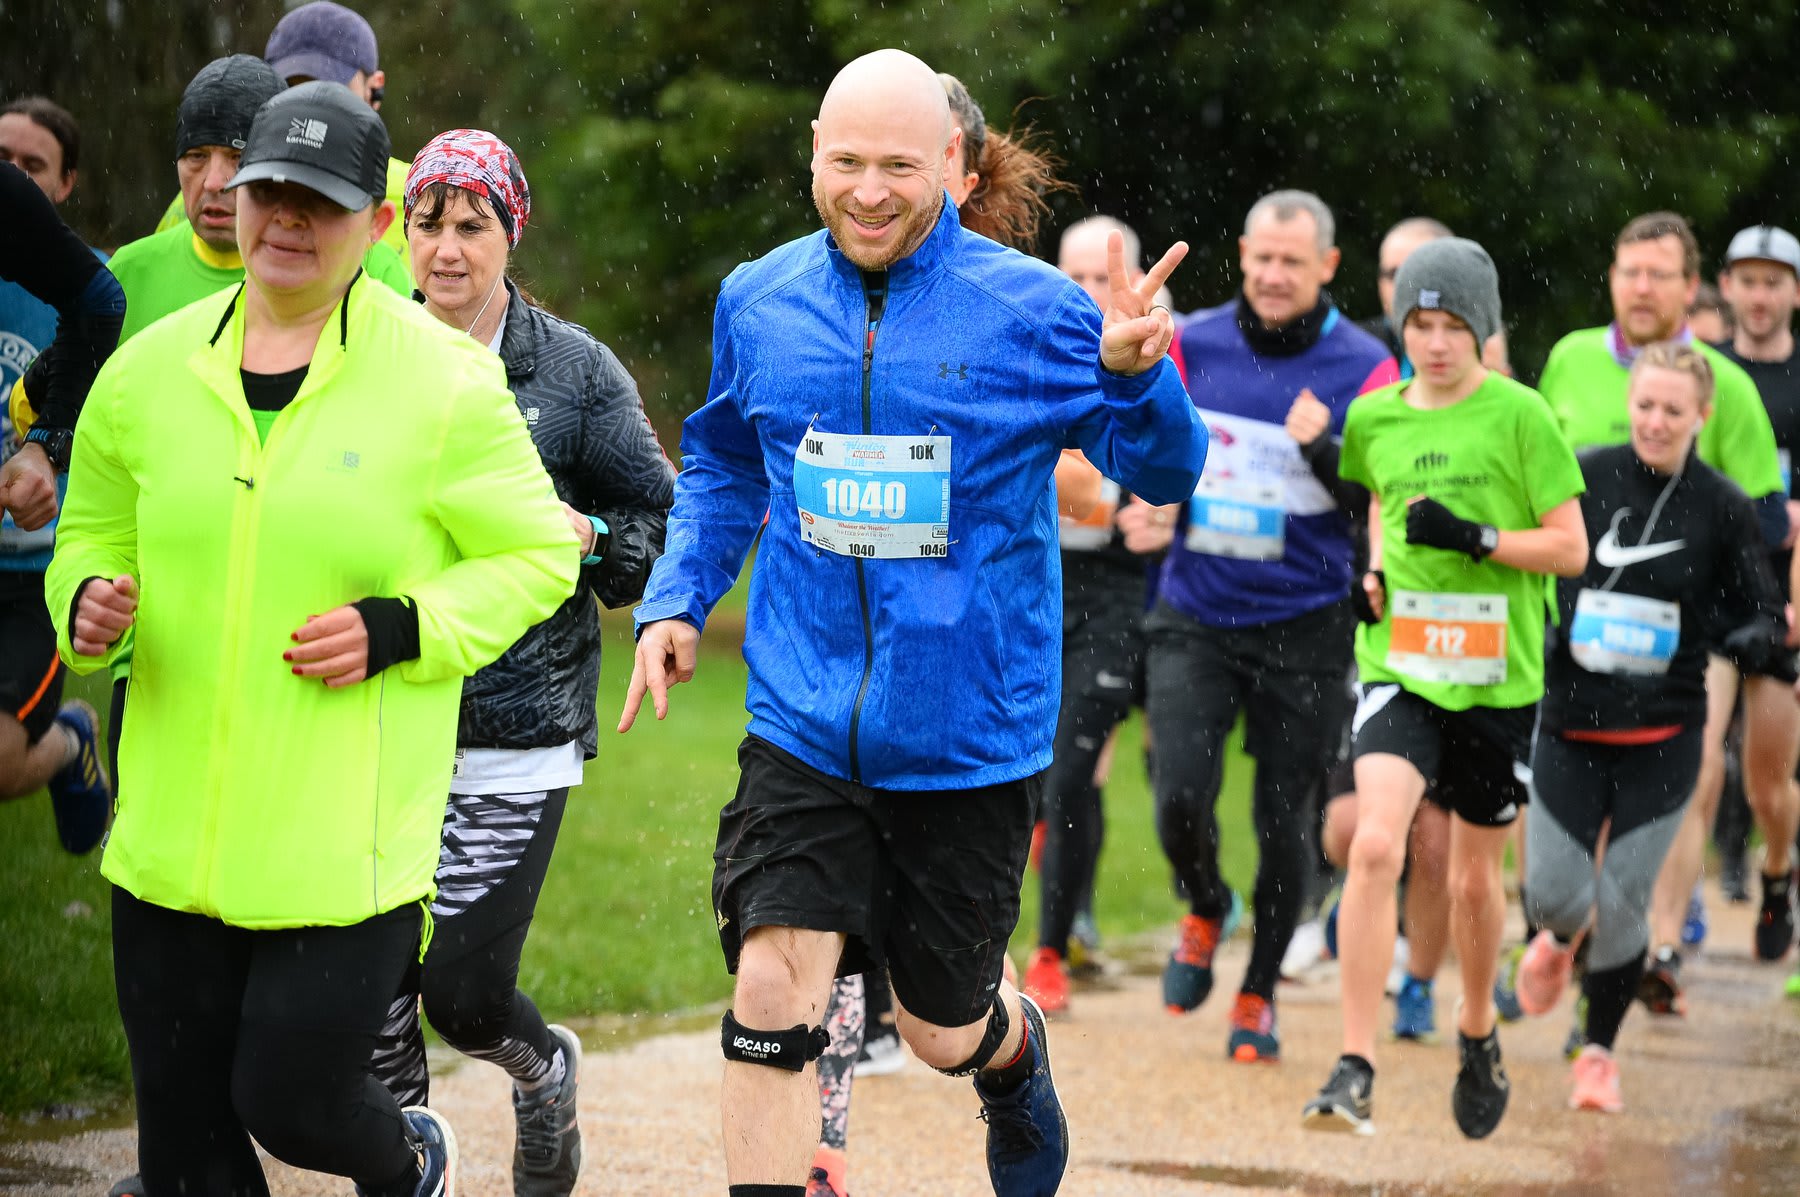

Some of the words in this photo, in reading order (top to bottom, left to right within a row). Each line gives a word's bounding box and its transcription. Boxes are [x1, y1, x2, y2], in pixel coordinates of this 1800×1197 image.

[805, 438, 824, 456] 10K
[909, 445, 935, 460] 10K
[853, 450, 885, 460] WARMER
[822, 477, 907, 519] 1040
[848, 543, 876, 557] 1040
[919, 544, 946, 556] 1040
[1424, 624, 1467, 654] 212
[742, 1049, 768, 1059] FITNESS
